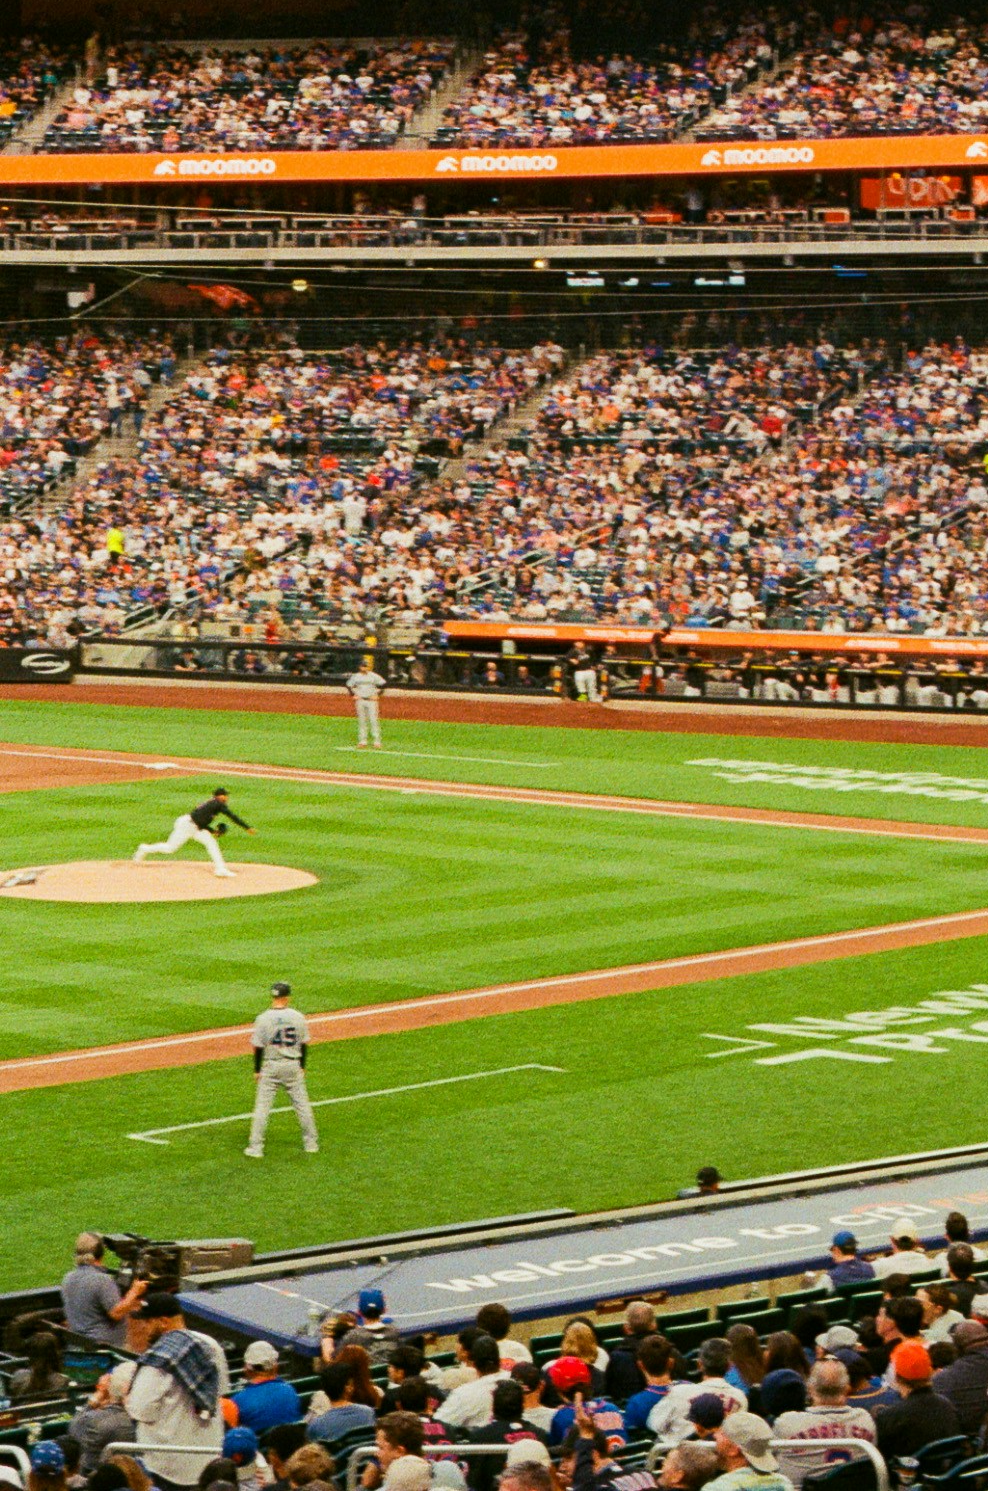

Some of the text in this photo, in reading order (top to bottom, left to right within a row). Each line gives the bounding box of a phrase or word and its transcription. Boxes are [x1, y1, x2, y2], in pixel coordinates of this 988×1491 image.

[461, 154, 557, 172] moomoo
[724, 147, 814, 165] moomoo
[178, 158, 275, 176] moomoo
[270, 1026, 298, 1047] 45
[425, 1235, 740, 1293] welcome
[739, 1223, 821, 1240] to
